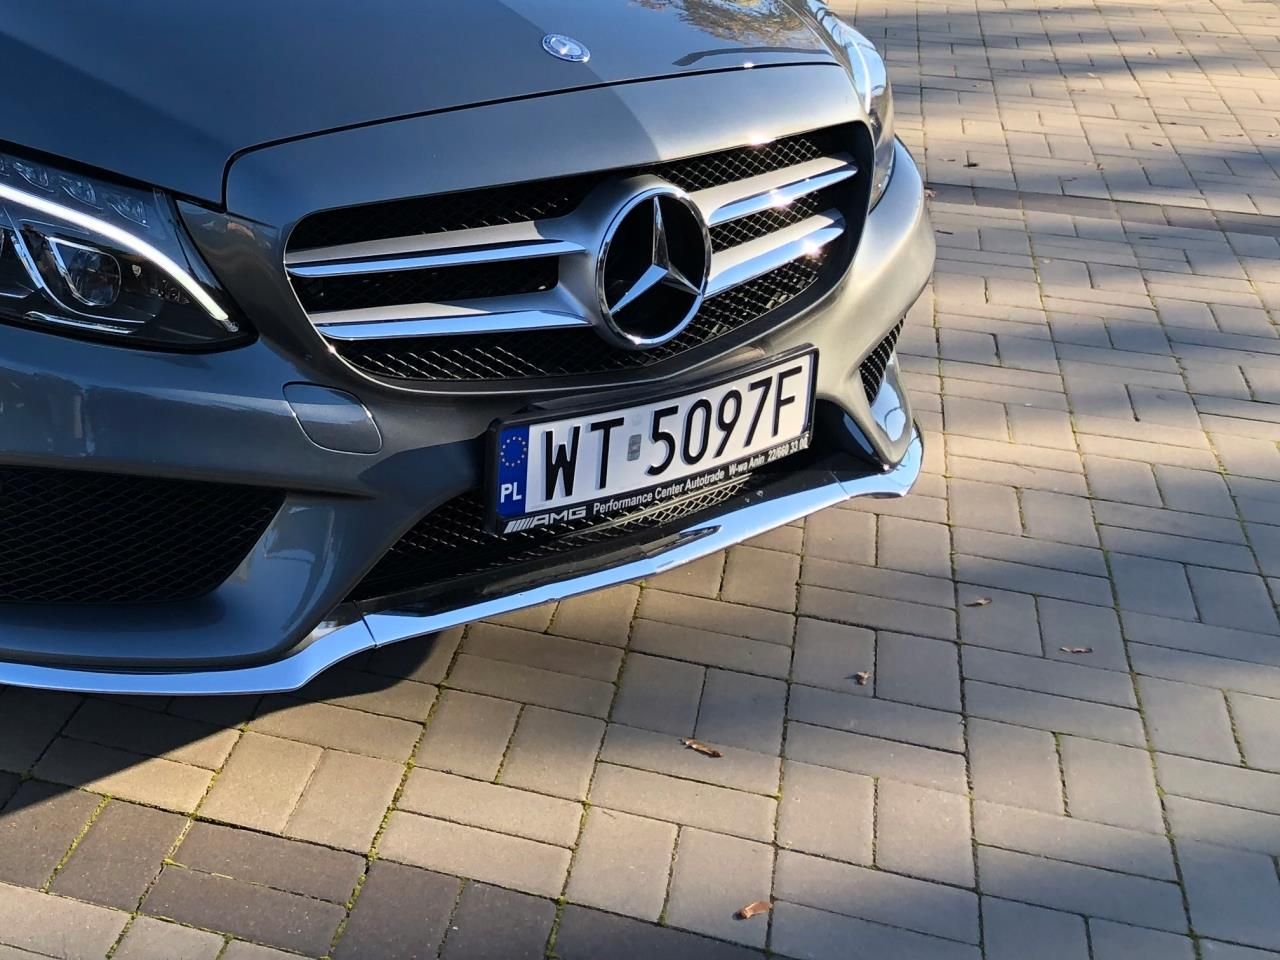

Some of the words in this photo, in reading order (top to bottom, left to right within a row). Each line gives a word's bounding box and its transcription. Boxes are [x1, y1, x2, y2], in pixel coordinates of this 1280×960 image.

[545, 417, 625, 502] WT
[645, 366, 803, 477] 5097F
[500, 482, 522, 503] PL
[531, 506, 587, 528] AMG
[593, 493, 653, 516] Performance
[655, 483, 683, 500] Center
[684, 468, 725, 490] Autotrade
[729, 461, 748, 476] W-wa
[748, 454, 766, 468] Anin
